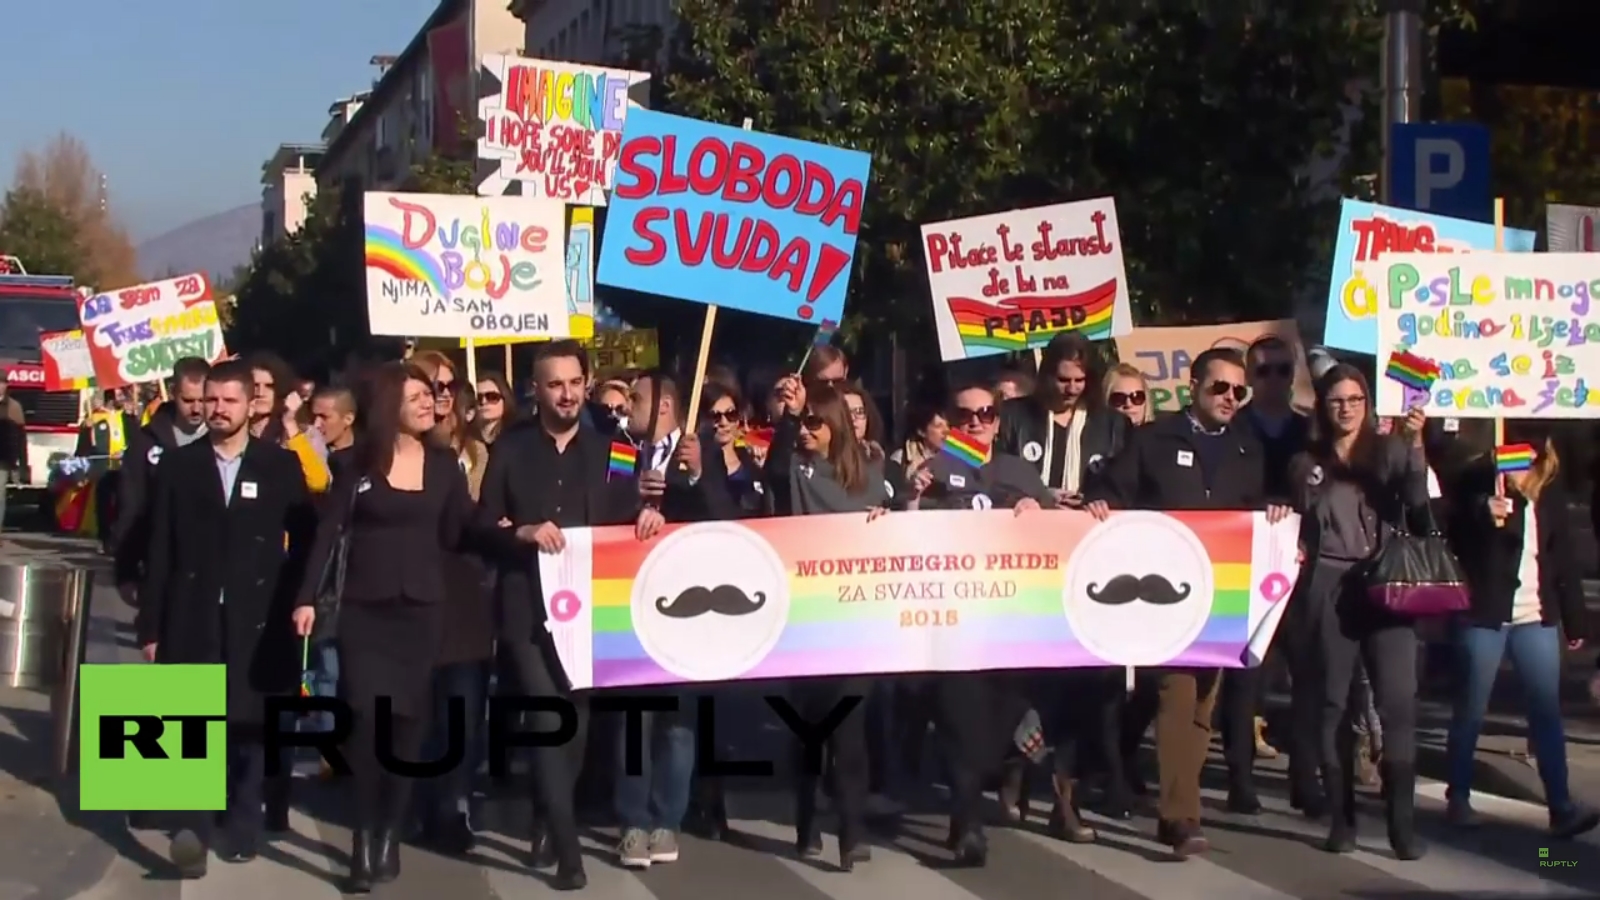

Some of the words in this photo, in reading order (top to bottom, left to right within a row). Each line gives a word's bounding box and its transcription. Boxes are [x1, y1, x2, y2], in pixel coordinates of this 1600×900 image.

[506, 65, 628, 133] IMAGINE
[488, 115, 496, 142] I
[500, 116, 541, 152] HOPE
[548, 125, 595, 156] SOME
[545, 173, 571, 199] US
[615, 135, 864, 235] SLOBODA
[1414, 138, 1466, 209] P
[996, 223, 1024, 262] te
[1031, 210, 1113, 261] starost
[624, 206, 851, 319] SVUDA!
[1015, 265, 1037, 293] bi
[1043, 275, 1070, 291] na
[421, 299, 446, 316] JA
[453, 298, 493, 314] SAM
[984, 304, 1088, 338] PRAJD
[470, 314, 549, 332] OBOJEN
[1398, 308, 1506, 346] godina
[1510, 313, 1524, 339] i
[1489, 352, 1532, 377] se
[1541, 350, 1575, 379] iz
[795, 554, 976, 577] MONTENEGRO
[985, 553, 1059, 571] PRIDE
[838, 584, 867, 603] ZA
[874, 581, 945, 601] SVAKI
[953, 580, 1017, 600] GRAD
[900, 609, 959, 628] 2015
